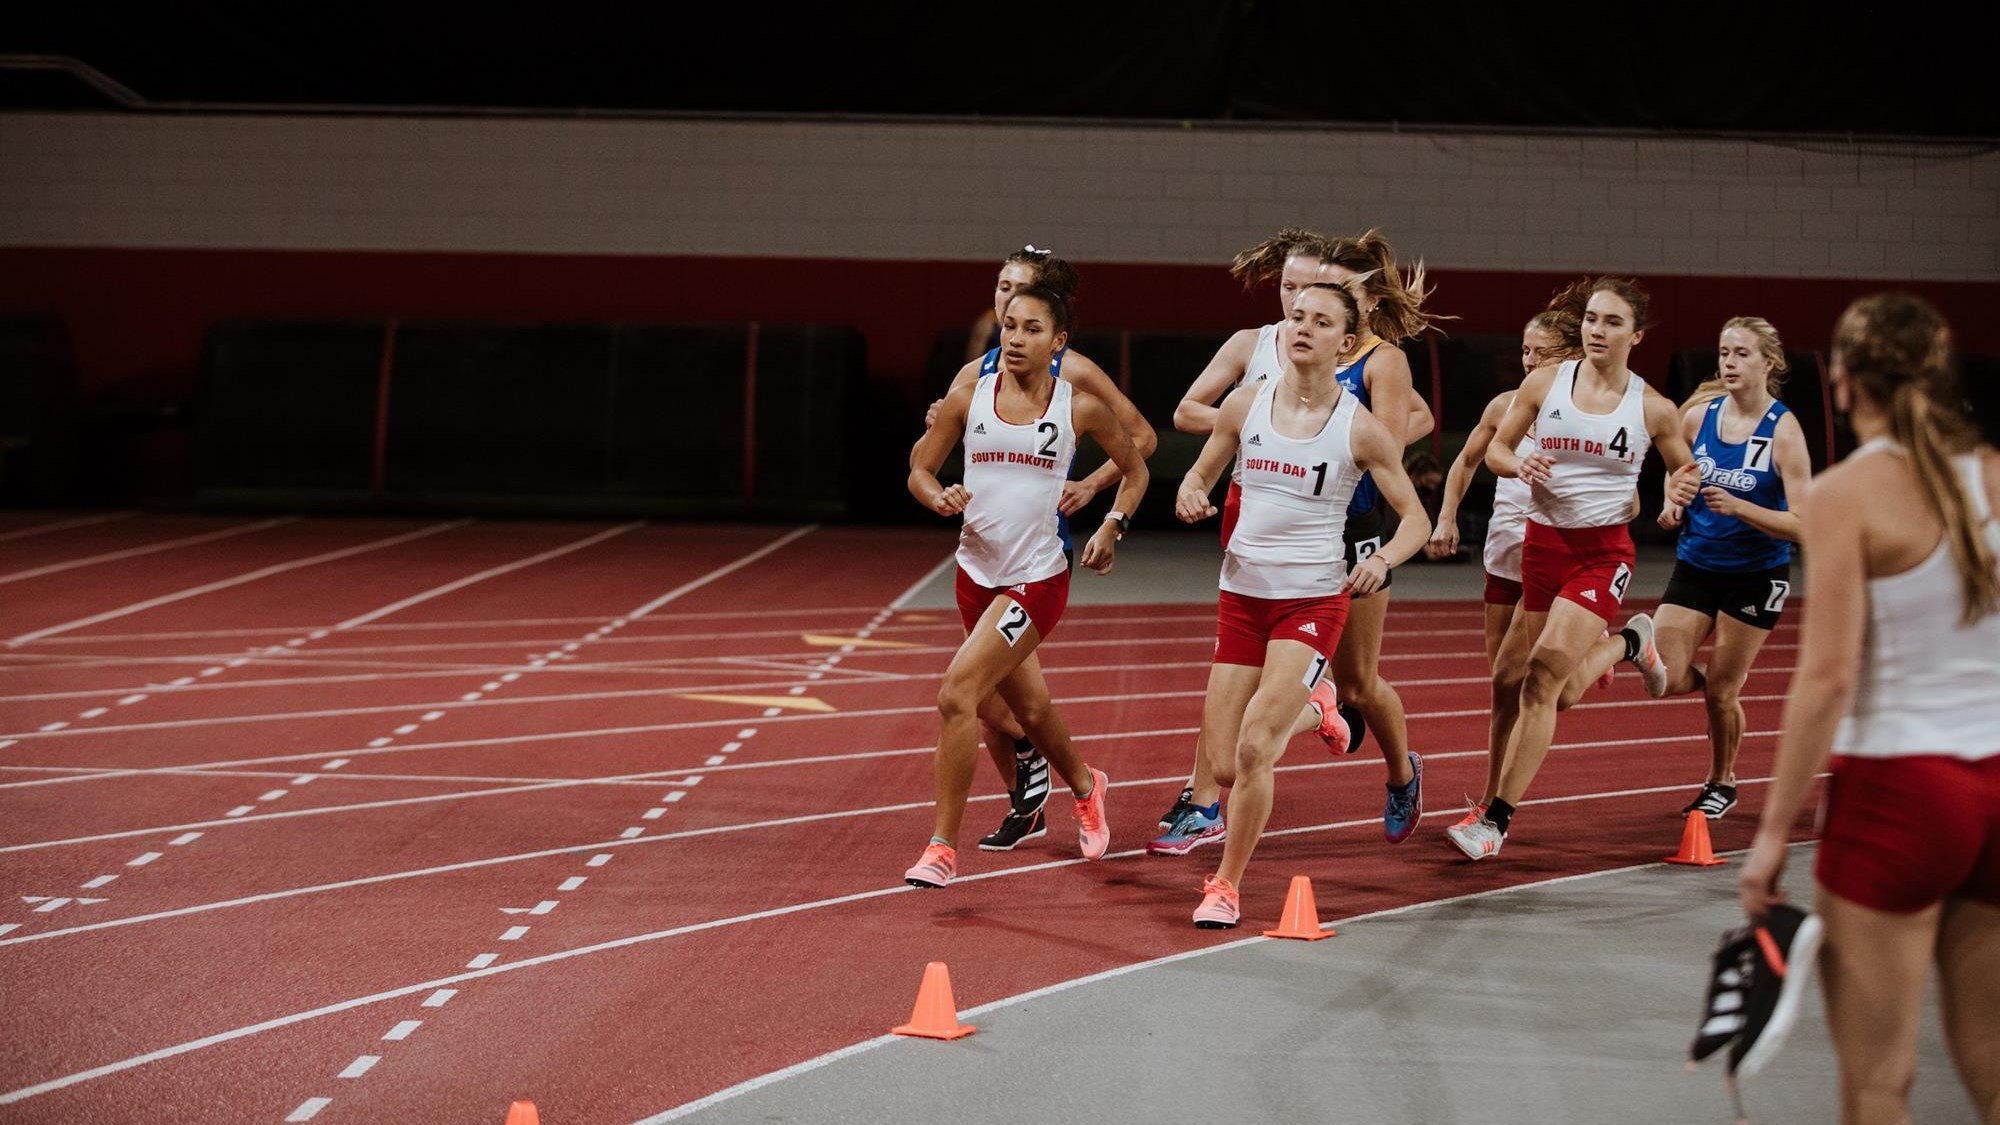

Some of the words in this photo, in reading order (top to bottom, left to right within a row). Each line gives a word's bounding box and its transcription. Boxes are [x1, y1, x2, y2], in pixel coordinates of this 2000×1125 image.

[1038, 422, 1059, 457] 2
[1541, 437, 1580, 451] SOUTH
[1609, 427, 1628, 458] 4
[1751, 439, 1769, 468] 7
[971, 452, 1005, 464] SOUTH
[1008, 452, 1054, 470] DAKOTA
[1246, 458, 1279, 473] SOUTH
[1696, 457, 1757, 492] Drake
[1312, 462, 1328, 496] 1
[1614, 571, 1629, 598] 4
[1769, 582, 1786, 609] 7
[1000, 606, 1027, 642] 2
[1310, 657, 1327, 689] 1
